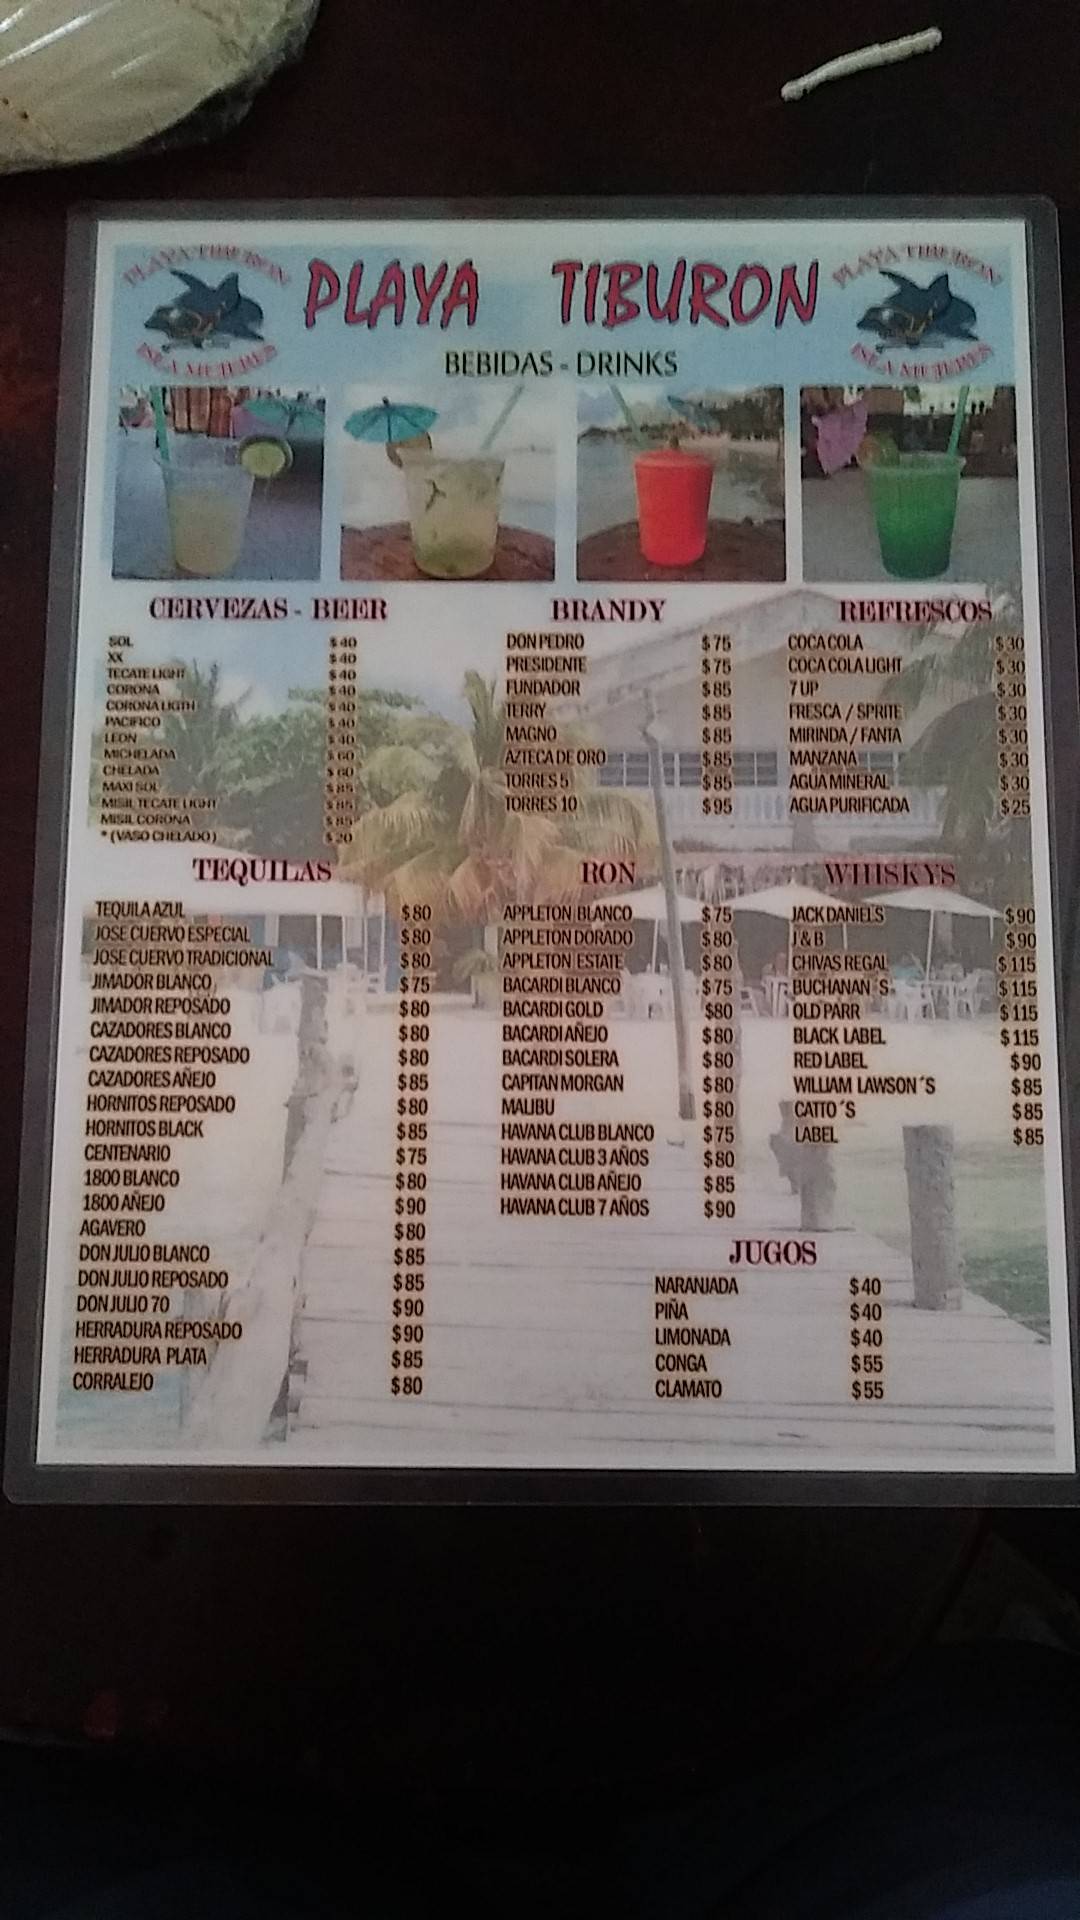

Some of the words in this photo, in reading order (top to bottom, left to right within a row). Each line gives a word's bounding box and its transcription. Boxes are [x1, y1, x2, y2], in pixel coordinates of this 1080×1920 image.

[304, 258, 480, 330] PLAYA
[552, 257, 820, 329] TIBURON
[445, 350, 553, 378] BEBIDAS
[577, 350, 678, 376] DRINKS
[150, 598, 288, 620] CERVEZAS
[312, 598, 387, 620] BEER
[552, 599, 666, 622] BRANDY
[839, 600, 992, 623] REFRESCOS
[506, 633, 537, 650] DON
[539, 633, 584, 650] PEDRO
[788, 635, 826, 652] COCA
[827, 635, 863, 652] COLA
[506, 656, 586, 673] PRESIDENTE
[788, 657, 826, 673] COCA
[828, 657, 863, 673] COLA
[865, 657, 902, 673] LIGHT
[506, 679, 580, 696] FUNDADOR
[790, 680, 797, 696] 7
[800, 680, 819, 696] UP
[506, 703, 546, 719] TERRY
[789, 704, 841, 720] FRESCA
[857, 704, 902, 720] SPRITE
[506, 726, 556, 742] MAGNO
[789, 727, 848, 743] MIRINDA
[861, 727, 902, 743] FANTA
[505, 750, 554, 766] AZTECA
[556, 750, 575, 766] DE
[577, 750, 606, 766] ORO
[789, 751, 857, 766] MANZANA
[505, 773, 557, 789] TORRES
[559, 773, 568, 789] 5
[789, 774, 828, 790] AGUA
[830, 774, 890, 790] MINERAL
[505, 796, 557, 812] TORRES
[562, 796, 577, 812] 10
[789, 797, 829, 813] AGUA
[830, 797, 910, 813] PURIFICADA
[192, 858, 332, 886] TEQUILAS
[582, 861, 635, 885] RON
[824, 862, 956, 886] WHISKYS
[97, 901, 151, 919] TEQUILA
[153, 901, 185, 919] AZUL
[503, 905, 571, 921] APPLETON
[577, 905, 632, 921] BLANCO
[792, 906, 824, 923] JACK
[95, 926, 126, 943] JOSE
[130, 926, 185, 943] CUERVO
[188, 926, 251, 943] ESPECIAL
[503, 929, 571, 946] APPLETON
[574, 929, 633, 946] DORADO
[93, 950, 126, 967] JOSE
[129, 950, 185, 967] CUERVO
[186, 950, 273, 967] TRADICIONAL
[503, 953, 571, 970] APPLETON
[577, 953, 623, 970] ESTATE
[792, 955, 841, 972] CHIVAS
[844, 955, 887, 972] REGAL
[92, 974, 153, 990] JIMADOR
[156, 974, 211, 990] BLANCO
[503, 977, 562, 994] BACARDI
[565, 977, 621, 994] BLANCO
[90, 998, 153, 1015] JIMADOR
[155, 998, 230, 1015] REPOSADO
[503, 1001, 562, 1018] BACARDI
[565, 1001, 603, 1018] GOLD
[793, 1004, 821, 1020] OLD
[823, 1004, 860, 1020] PARR
[90, 1022, 173, 1039] CAZADORES
[175, 1022, 232, 1039] BLANCO
[502, 1025, 562, 1042] BACARDI
[564, 1022, 608, 1042] AÑEJO
[793, 1028, 838, 1045] BLACK
[844, 1028, 886, 1045] LABEL
[89, 1047, 172, 1063] CAZADORES
[175, 1047, 250, 1063] REPOSADO
[502, 1050, 562, 1067] BACARDI
[564, 1050, 619, 1067] SOLERA
[794, 1052, 822, 1069] RED
[825, 1052, 867, 1069] LABEL
[88, 1071, 171, 1088] CAZADORES
[173, 1067, 216, 1088] AÑEJO
[502, 1074, 558, 1091] CAPITAN
[560, 1074, 623, 1091] MORGAN
[793, 1077, 852, 1094] WILLIAM
[87, 1095, 157, 1113] HORNITOS
[160, 1095, 235, 1113] REPOSADO
[502, 1099, 554, 1116] MALIBU
[85, 1120, 157, 1138] HORNITOS
[159, 1120, 204, 1138] BLACK
[501, 1124, 556, 1141] HAVANA
[559, 1124, 594, 1141] CLUB
[597, 1124, 654, 1141] BLANCO
[795, 1126, 838, 1143] LABEL
[84, 1145, 170, 1161] CENTENARIO
[501, 1149, 556, 1166] HAVANA
[559, 1149, 594, 1166] CLUB
[598, 1149, 606, 1166] 3
[609, 1145, 649, 1166] AÑOS
[84, 1170, 121, 1187] 1800
[123, 1170, 179, 1187] BLANCO
[501, 1174, 556, 1191] HAVANA
[559, 1174, 594, 1191] CLUB
[597, 1170, 641, 1191] AÑEJO
[83, 1195, 119, 1211] 1800
[121, 1191, 165, 1211] AÑEJO
[500, 1199, 556, 1216] HAVANA
[558, 1199, 594, 1216] CLUB
[599, 1199, 606, 1216] 7
[609, 1195, 649, 1216] AÑOS
[80, 1220, 146, 1236] AGAVERO
[79, 1245, 111, 1262] DON
[113, 1245, 150, 1262] JULIO
[153, 1245, 210, 1262] BLANCO
[729, 1240, 817, 1265] JUGOS
[78, 1271, 109, 1288] DON
[111, 1271, 149, 1288] JULIO
[151, 1271, 228, 1288] REPOSADO
[655, 1277, 739, 1295] NARANJADA
[77, 1296, 109, 1313] DON
[110, 1296, 148, 1313] JULIO
[151, 1296, 170, 1313] 70
[655, 1299, 688, 1320] PIÑA
[75, 1322, 162, 1339] HERRADURA
[165, 1322, 242, 1339] REPOSADO
[655, 1328, 731, 1346] LIMONADA
[74, 1347, 161, 1365] HERRADURA
[166, 1347, 207, 1365] PLATA
[655, 1354, 707, 1372] CONGA
[72, 1373, 154, 1391] CORRALEJO
[656, 1380, 722, 1398] CLAMATO
